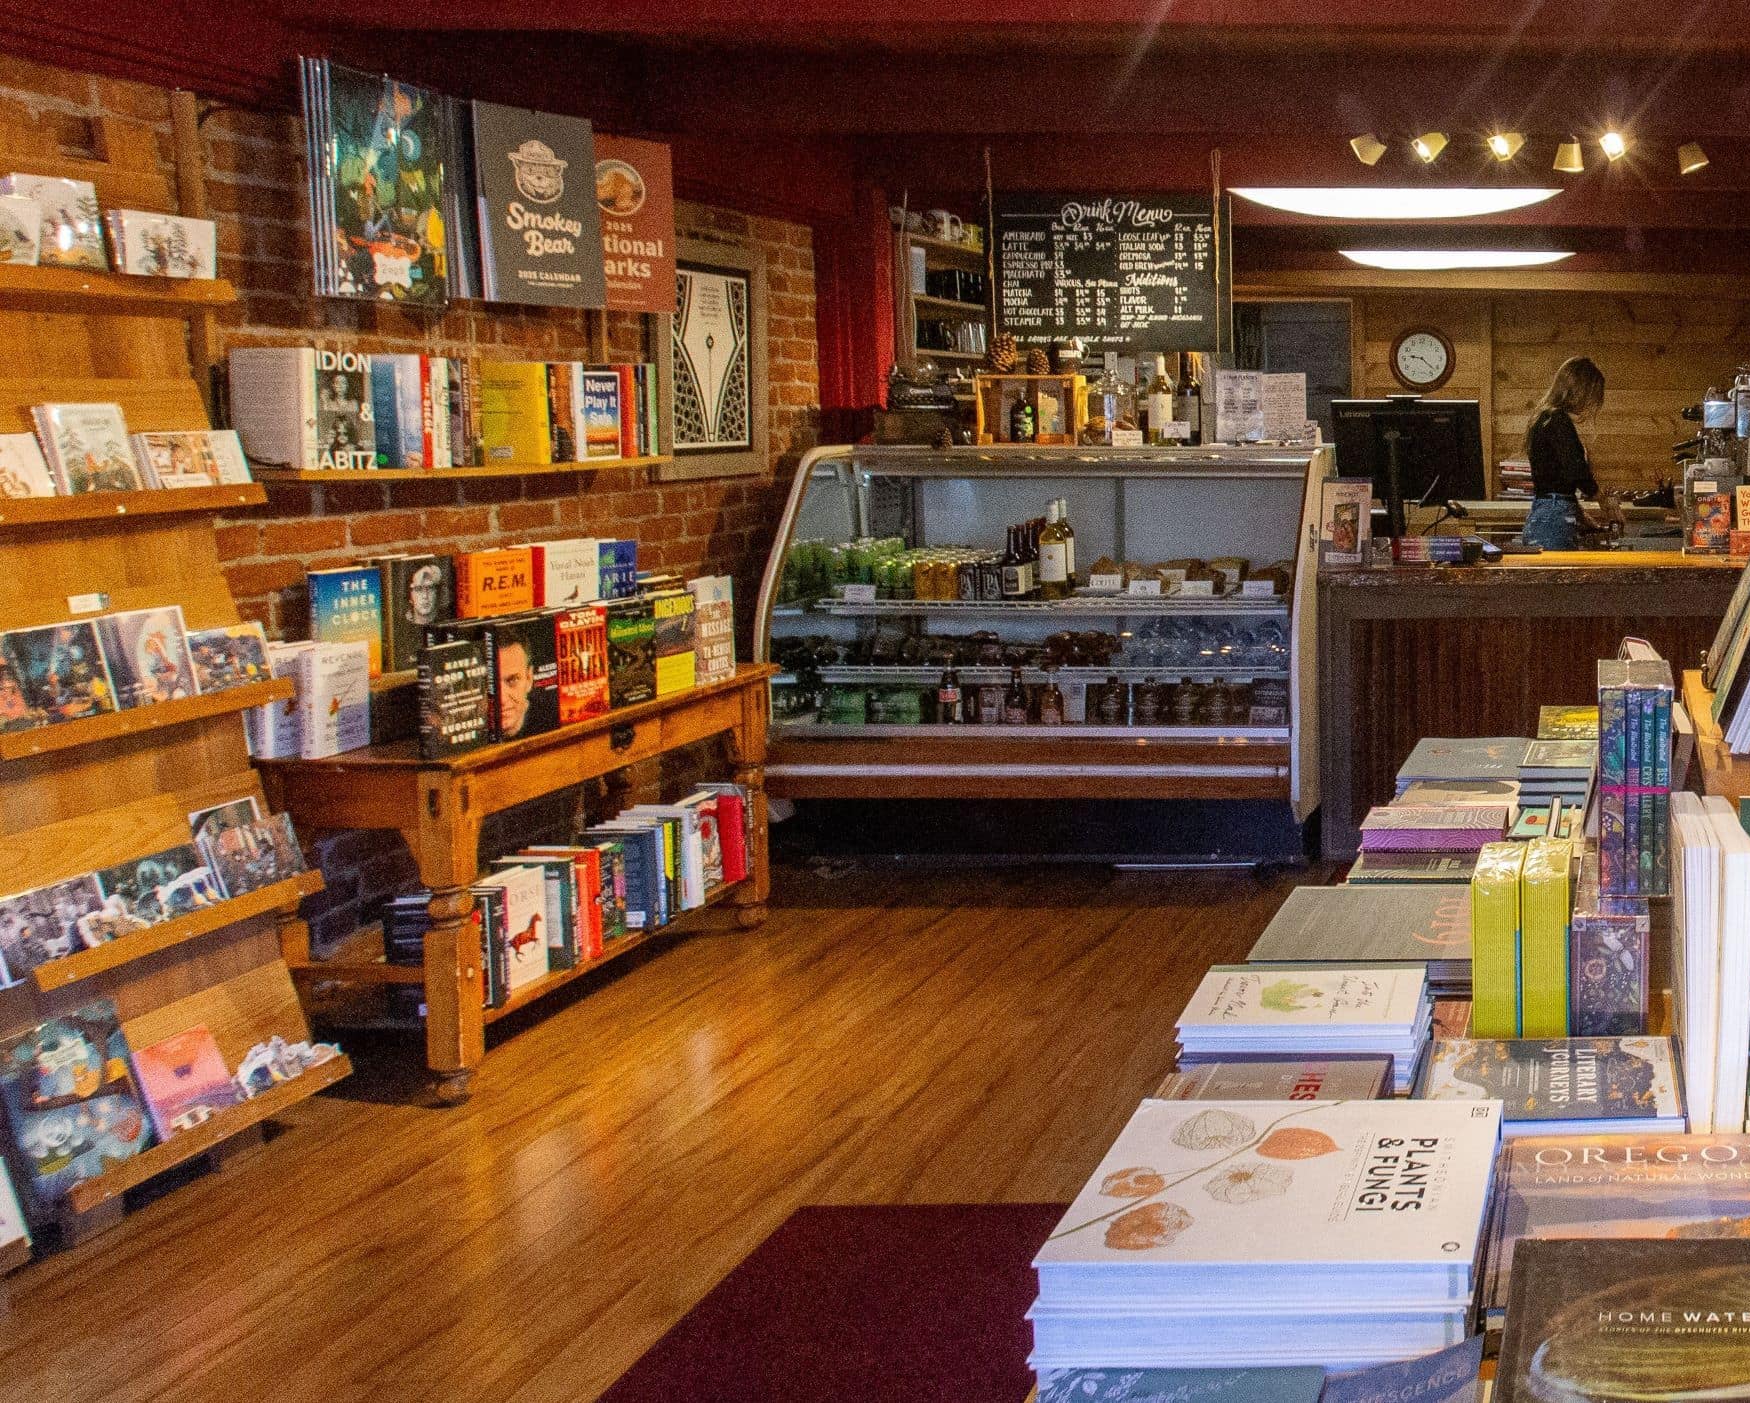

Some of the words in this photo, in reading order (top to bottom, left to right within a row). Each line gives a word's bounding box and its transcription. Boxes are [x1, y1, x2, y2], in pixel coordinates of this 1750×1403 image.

[506, 202, 582, 237] Smokey
[1061, 199, 1114, 227] Drink
[1113, 201, 1172, 227] Menu
[523, 229, 575, 257] Bear
[1003, 232, 1046, 241] AMERICANO
[1002, 242, 1029, 251] LATTE
[1120, 243, 1146, 251] ITALIAN
[1148, 242, 1165, 251] SODA
[1003, 252, 1046, 260] CAPPUCCINO
[1003, 261, 1039, 269] ESPRESSO
[1003, 270, 1046, 279] MACCHIATO
[1124, 273, 1179, 286] Additions
[1003, 298, 1029, 307] MOCHA
[1120, 296, 1147, 305] FLAVOR
[586, 379, 616, 392] Never
[585, 396, 609, 409] Play
[609, 396, 617, 407] It
[360, 402, 375, 422] &
[341, 579, 368, 592] THE
[482, 573, 526, 592] R.E.M.
[333, 593, 375, 609] INNER
[569, 610, 598, 620] TOM
[559, 616, 606, 629] CLAVIN
[444, 658, 471, 671] HAVE
[471, 656, 478, 667] A
[434, 670, 464, 684] GOOD
[1574, 1048, 1597, 1103] LITERARY
[1377, 1137, 1405, 1149] &
[1390, 1138, 1440, 1212] PLANTS
[1535, 1174, 1585, 1185] LAND
[1589, 1174, 1602, 1184] of
[1608, 1172, 1694, 1184] NATURAL
[1355, 1155, 1400, 1211] FUNGI
[1598, 1312, 1672, 1323] HOME
